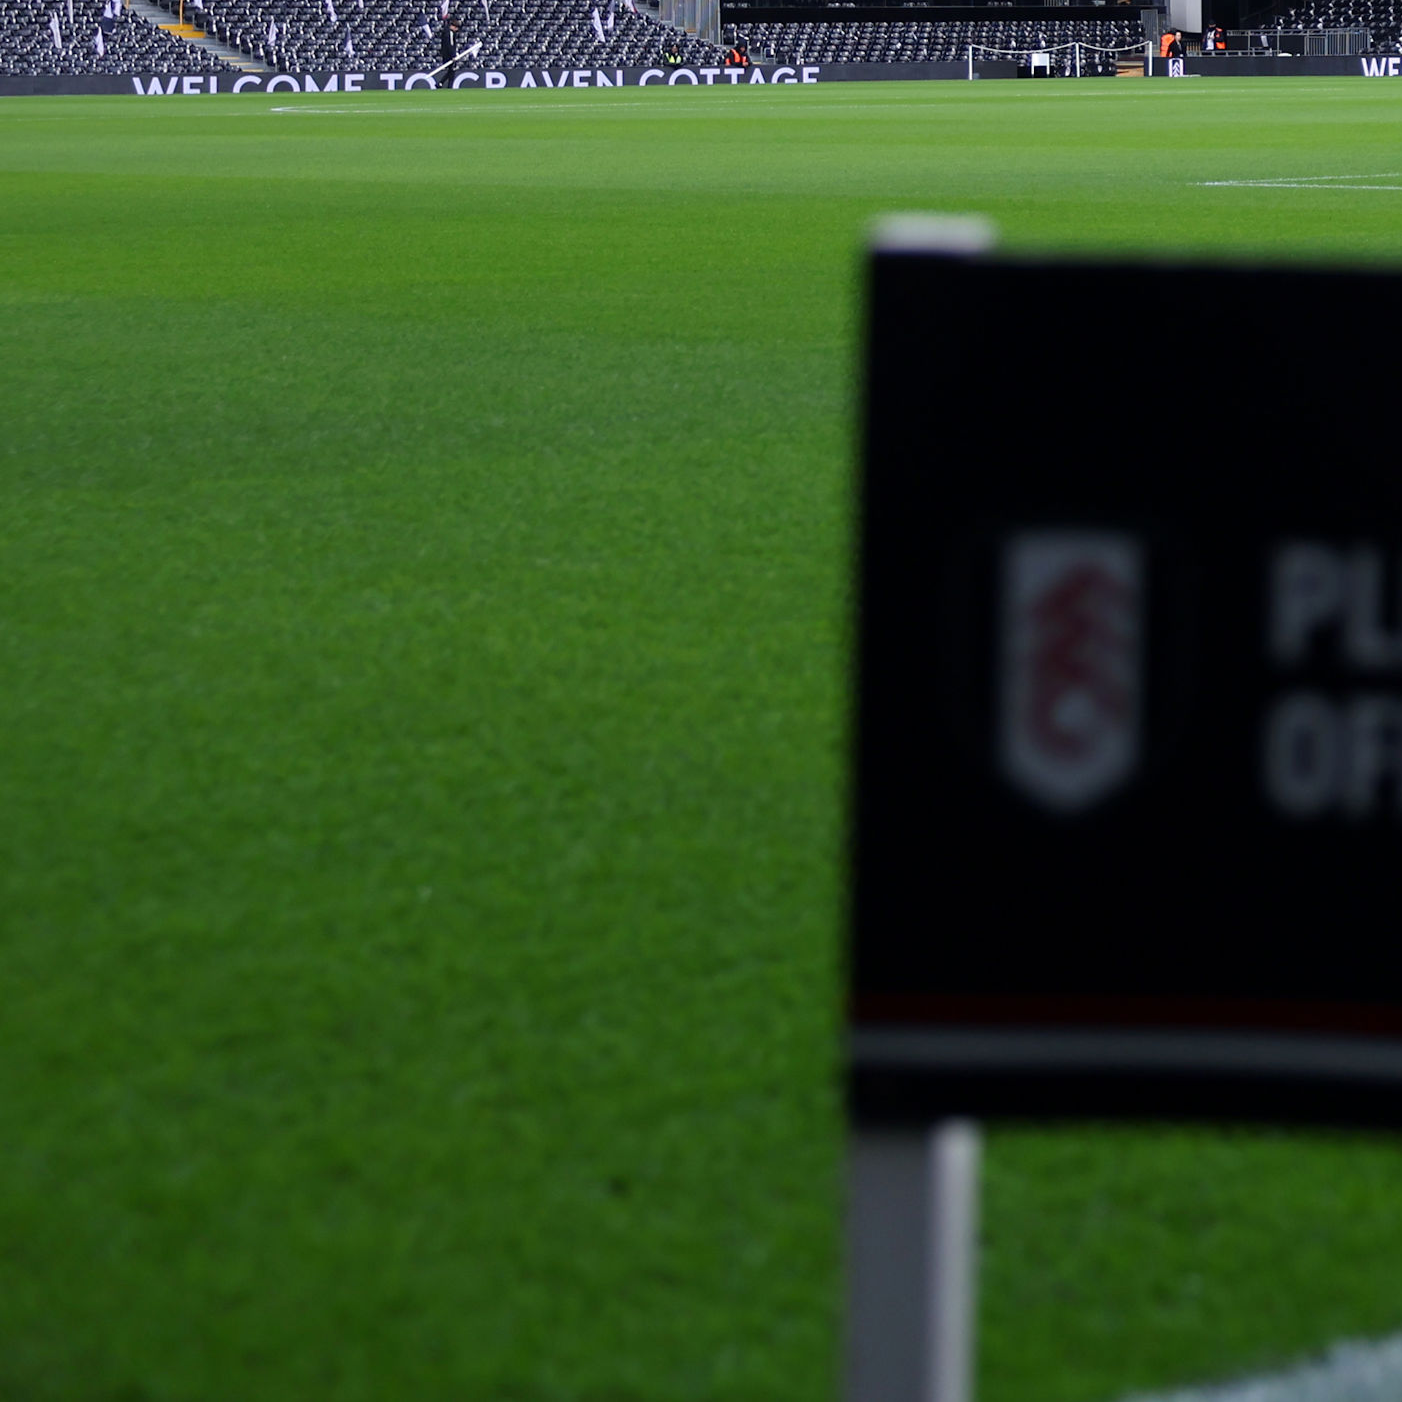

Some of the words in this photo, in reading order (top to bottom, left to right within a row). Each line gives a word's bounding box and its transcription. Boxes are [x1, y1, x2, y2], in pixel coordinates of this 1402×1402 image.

[379, 72, 438, 92] TO
[452, 67, 623, 90] CRAVEN
[638, 66, 820, 87] COTTAGE
